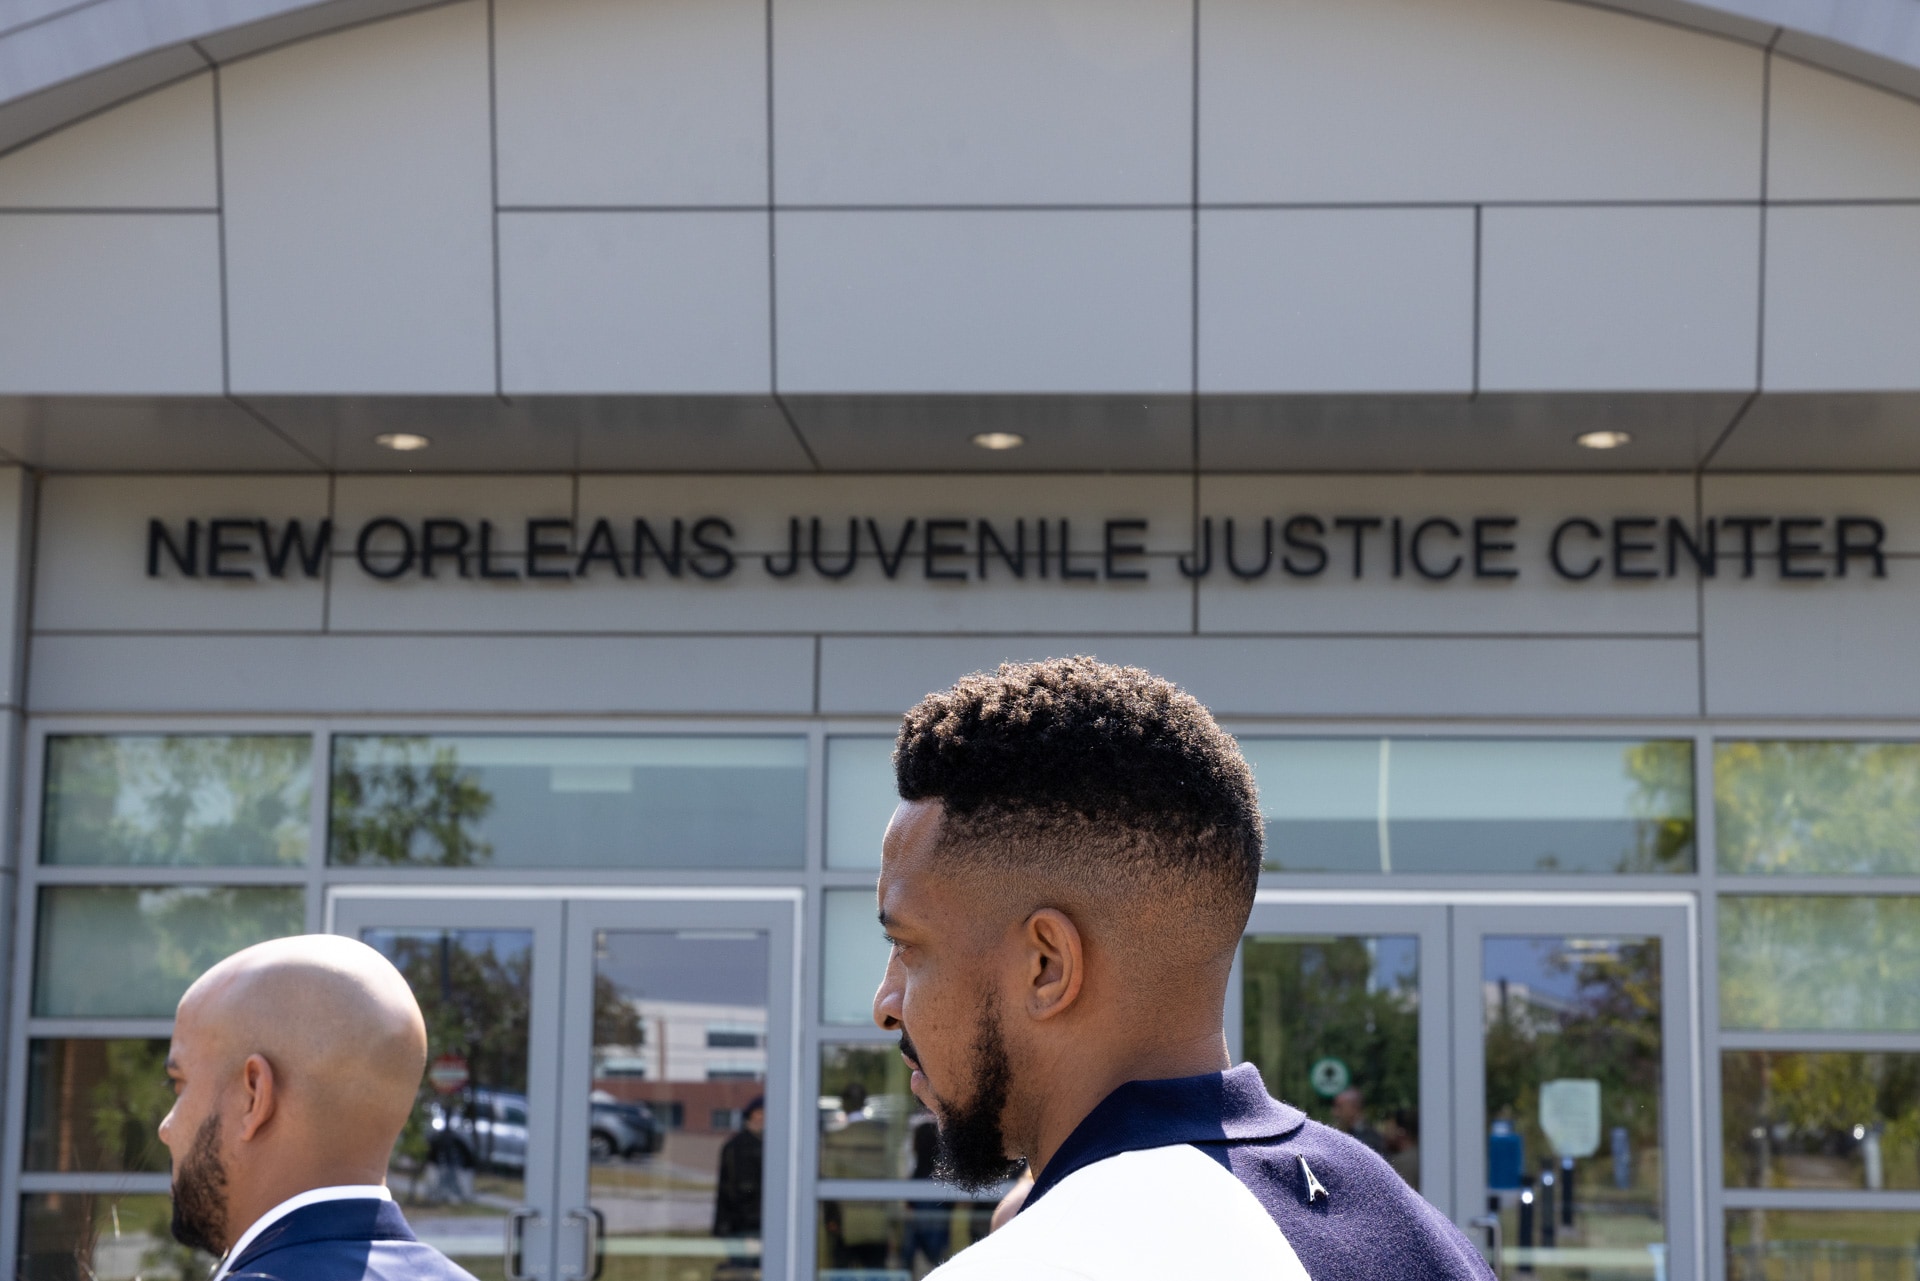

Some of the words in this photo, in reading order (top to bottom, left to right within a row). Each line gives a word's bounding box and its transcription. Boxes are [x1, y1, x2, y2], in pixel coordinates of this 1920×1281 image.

[147, 518, 331, 578] NEW
[356, 516, 736, 580] ORLEANS
[764, 516, 1149, 580] JUVENILE
[1178, 515, 1519, 580] JUSTICE
[1549, 515, 1888, 580] CENTER
